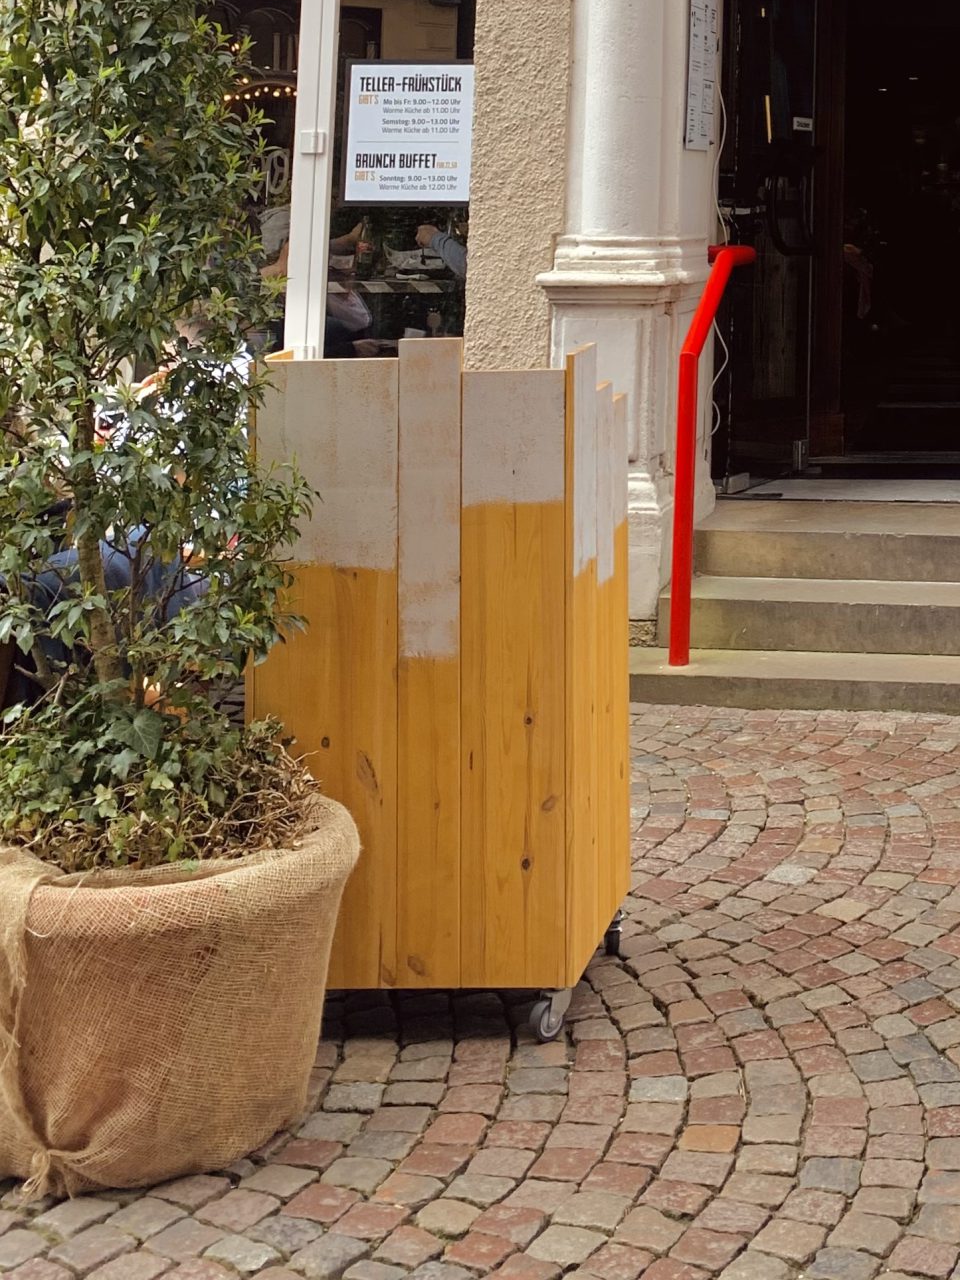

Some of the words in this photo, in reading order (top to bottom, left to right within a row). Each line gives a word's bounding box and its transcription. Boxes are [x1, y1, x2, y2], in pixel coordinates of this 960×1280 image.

[360, 74, 462, 93] TELLER-FRÜHSTÜCK
[355, 153, 396, 168] BRUNCH
[399, 153, 437, 168] BUFFET
